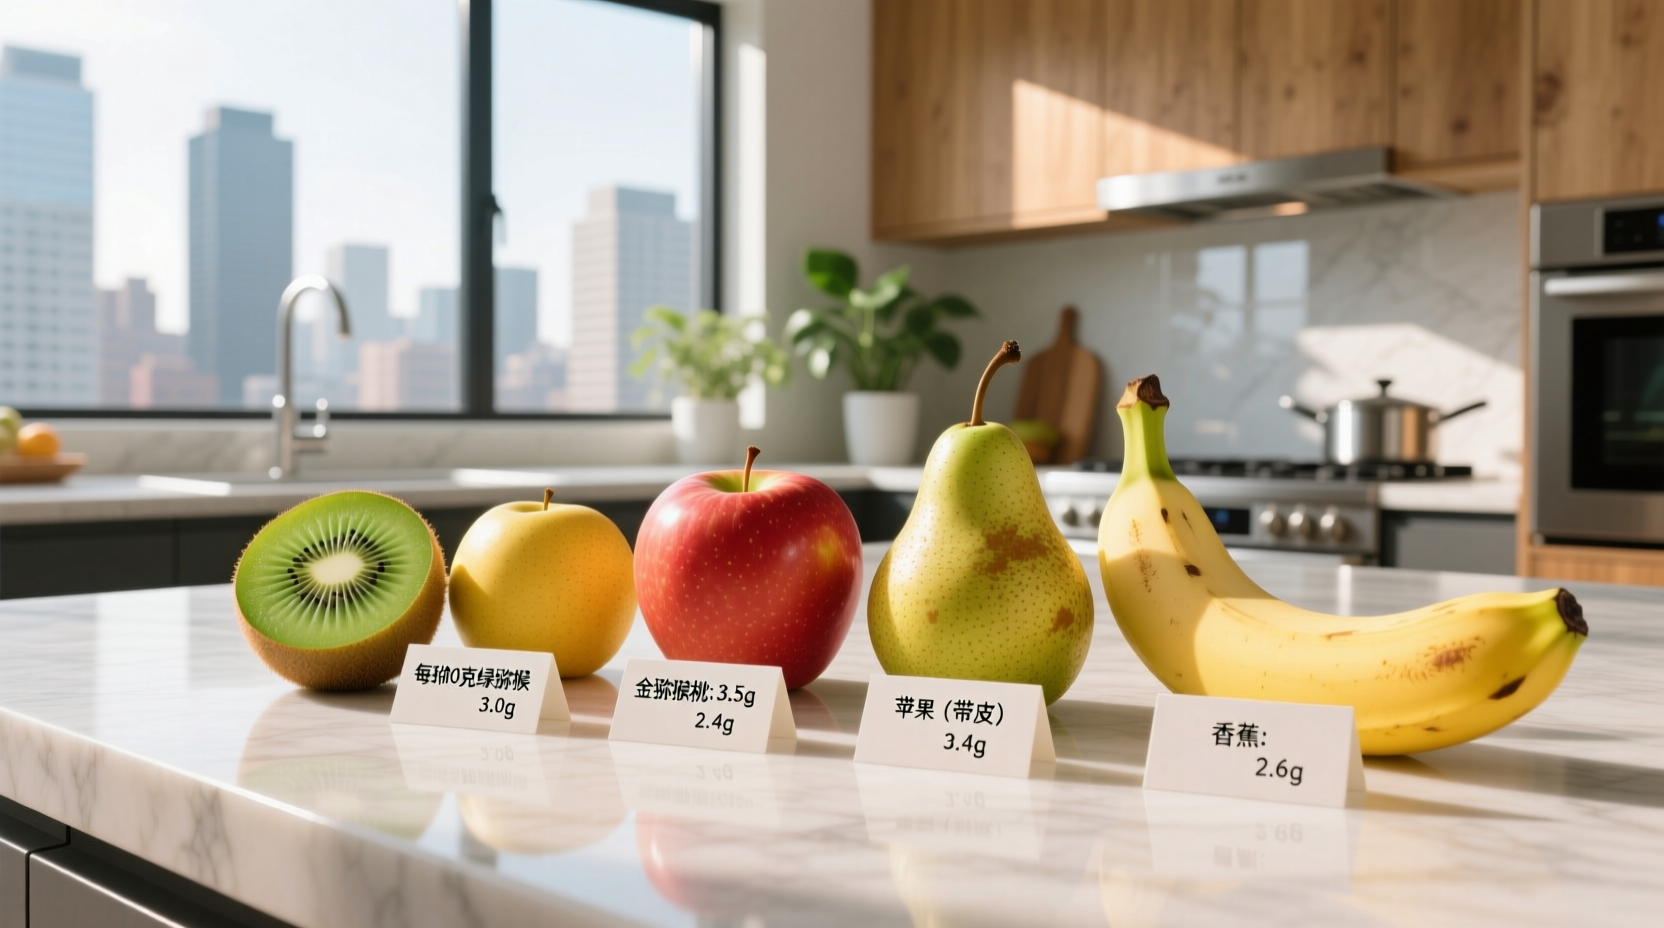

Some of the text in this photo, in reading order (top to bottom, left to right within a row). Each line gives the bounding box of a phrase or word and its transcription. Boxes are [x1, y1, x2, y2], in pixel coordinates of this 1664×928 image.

[479, 696, 516, 720] 3.0g
[694, 712, 735, 736] 2.4g
[1212, 722, 1267, 748] 香蕉:
[943, 732, 987, 759] 3.4g
[1255, 757, 1304, 787] 2.6g
